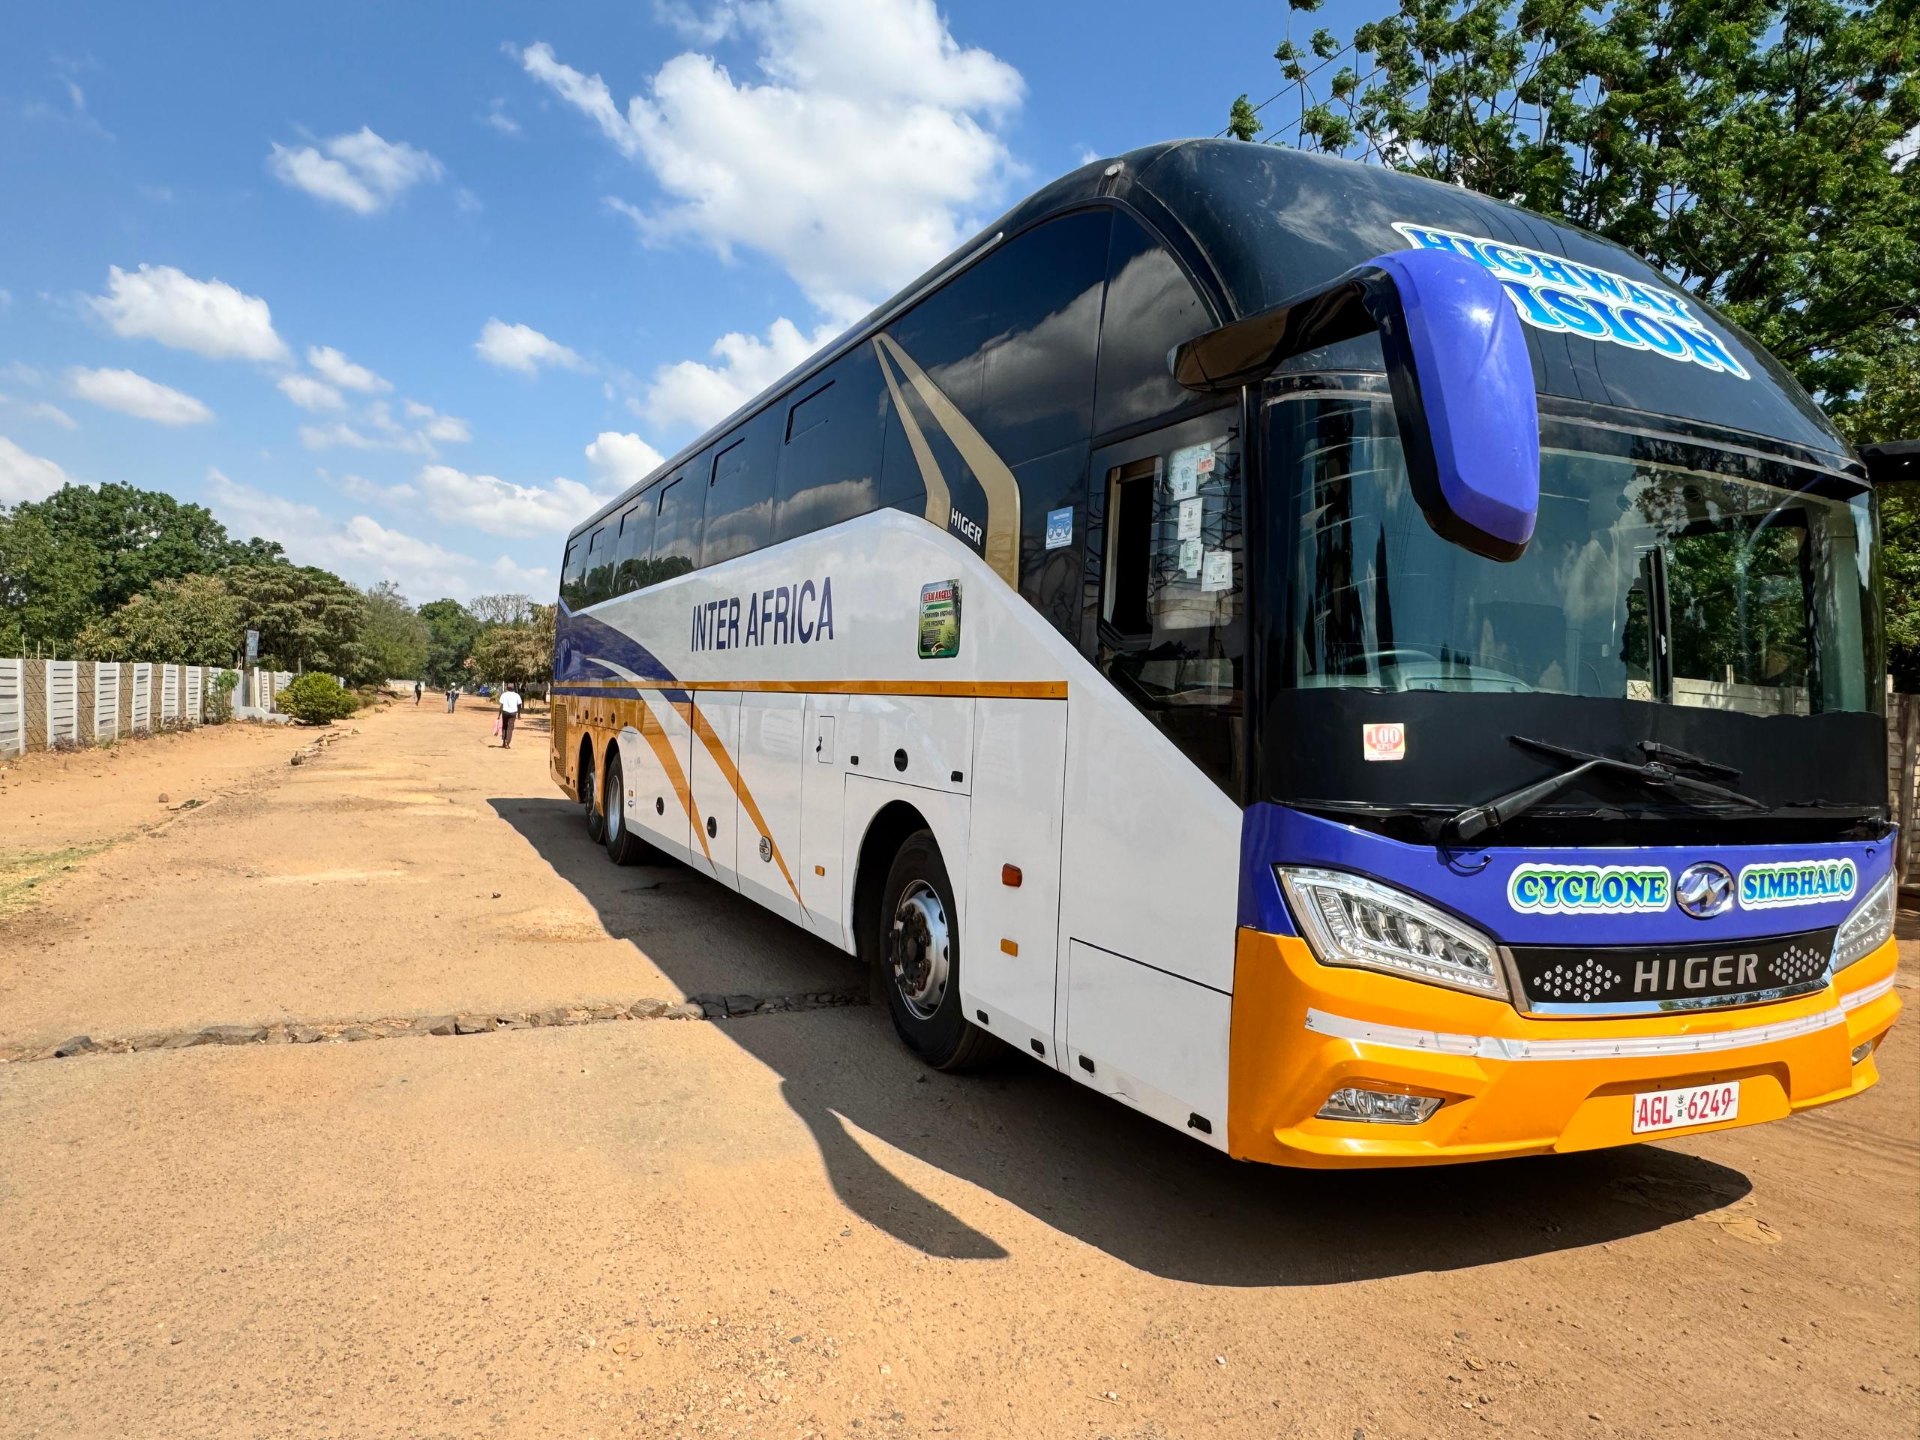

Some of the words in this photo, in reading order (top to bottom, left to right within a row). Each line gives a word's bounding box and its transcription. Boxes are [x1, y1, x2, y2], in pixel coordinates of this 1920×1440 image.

[1401, 227, 1697, 323] HIGHWAY
[1499, 279, 1749, 378] ISION
[951, 507, 983, 546] HIGER
[691, 596, 741, 652] INTER
[745, 576, 834, 648] AFRICA
[1370, 727, 1400, 744] 100
[1514, 872, 1668, 906] CYCLONE
[1741, 865, 1856, 901] SIMBHALO
[1633, 953, 1759, 993] HIGER
[1637, 1095, 1674, 1128] AGL
[1687, 1087, 1733, 1121] 6249
